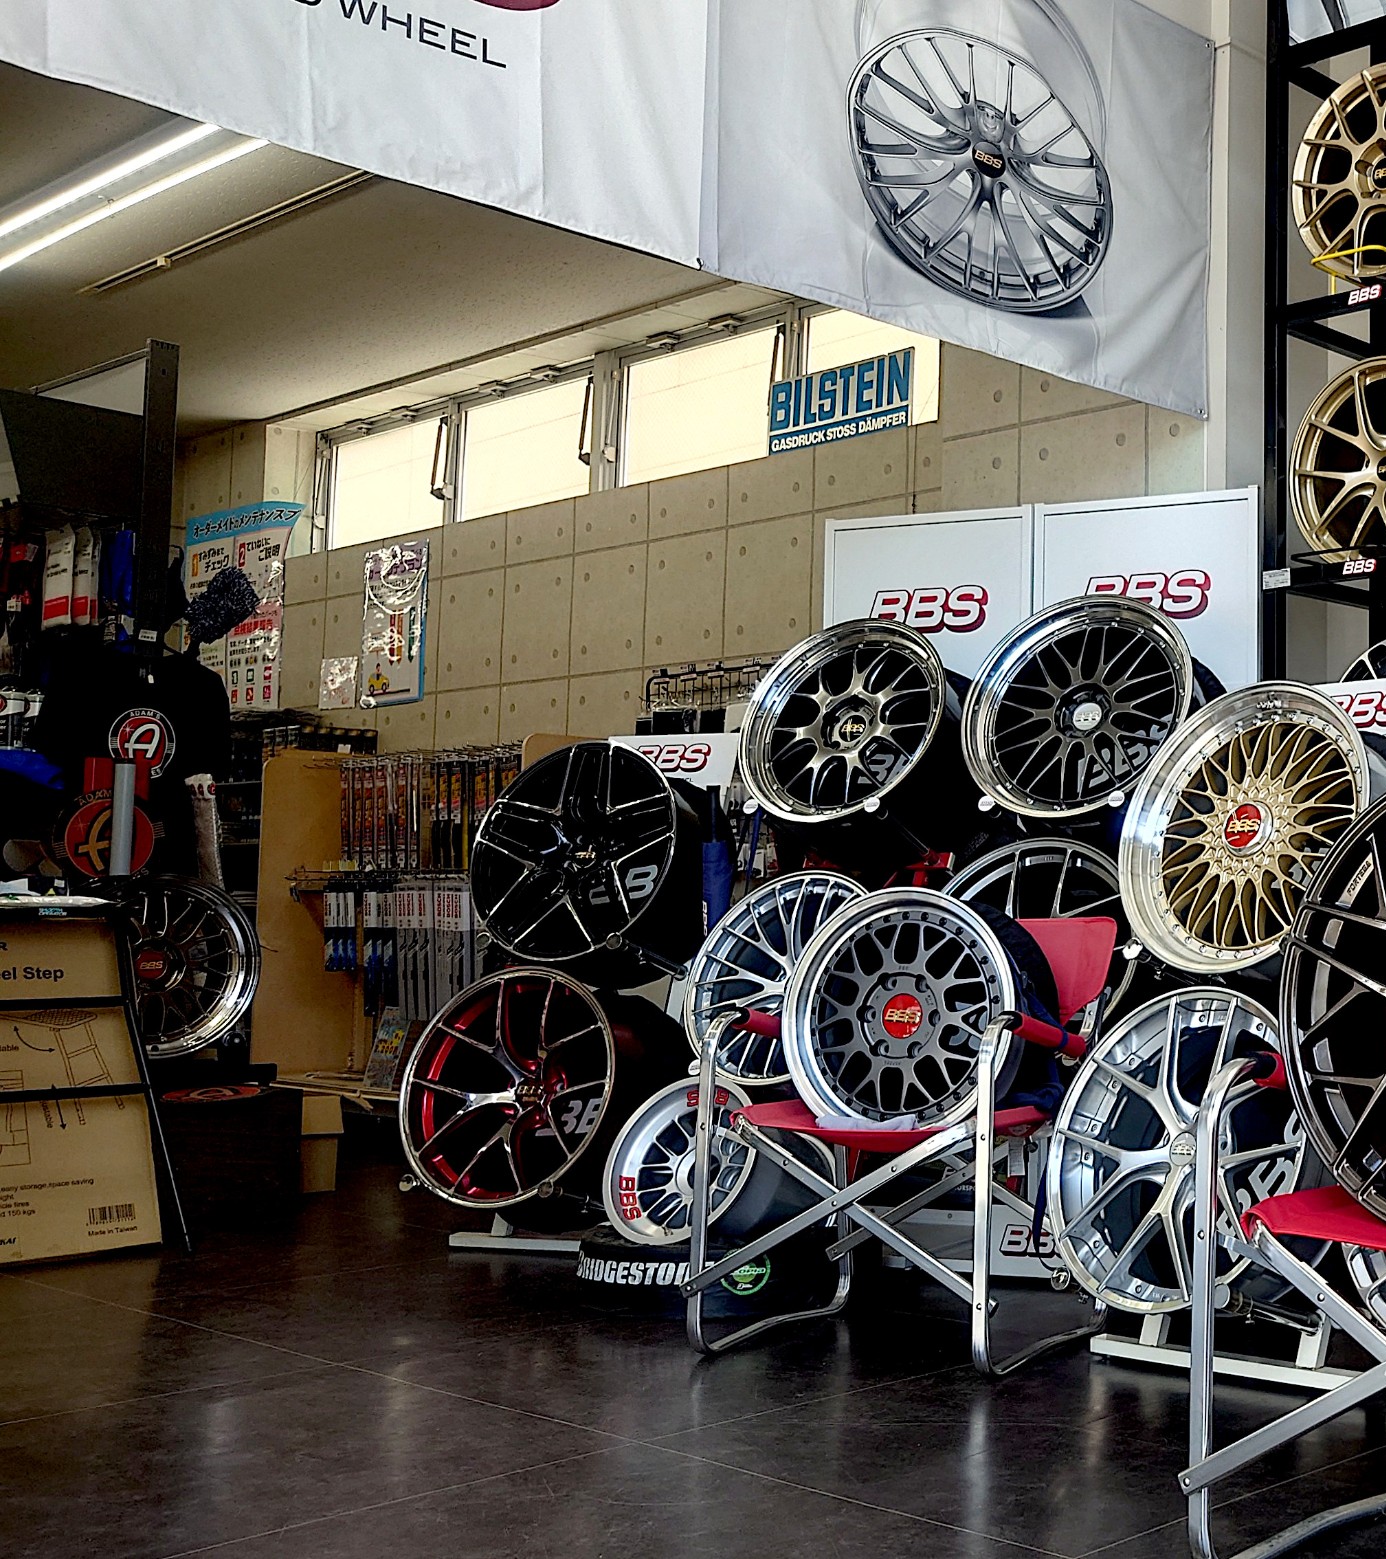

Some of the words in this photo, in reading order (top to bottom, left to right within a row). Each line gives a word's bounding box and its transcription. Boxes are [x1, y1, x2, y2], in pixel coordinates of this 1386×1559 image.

[974, 150, 1003, 169] BBS
[1347, 284, 1382, 306] BBS
[770, 350, 911, 432] BILSTEIN
[771, 431, 825, 452] GASDRUCK
[826, 425, 857, 441] STOSS
[858, 411, 906, 434] DÄMPFER
[204, 554, 230, 573] チェック
[1342, 558, 1377, 576] BBS
[869, 584, 989, 634] BBS
[129, 709, 161, 720] ADAM'S
[1227, 818, 1261, 834] BBS
[0, 967, 17, 980] el
[23, 967, 64, 982] Step
[884, 1008, 921, 1024] BBS
[71, 1177, 94, 1187] saving
[618, 1175, 642, 1221] BBS
[88, 1229, 106, 1237] Made
[115, 1226, 138, 1234] Taiwan
